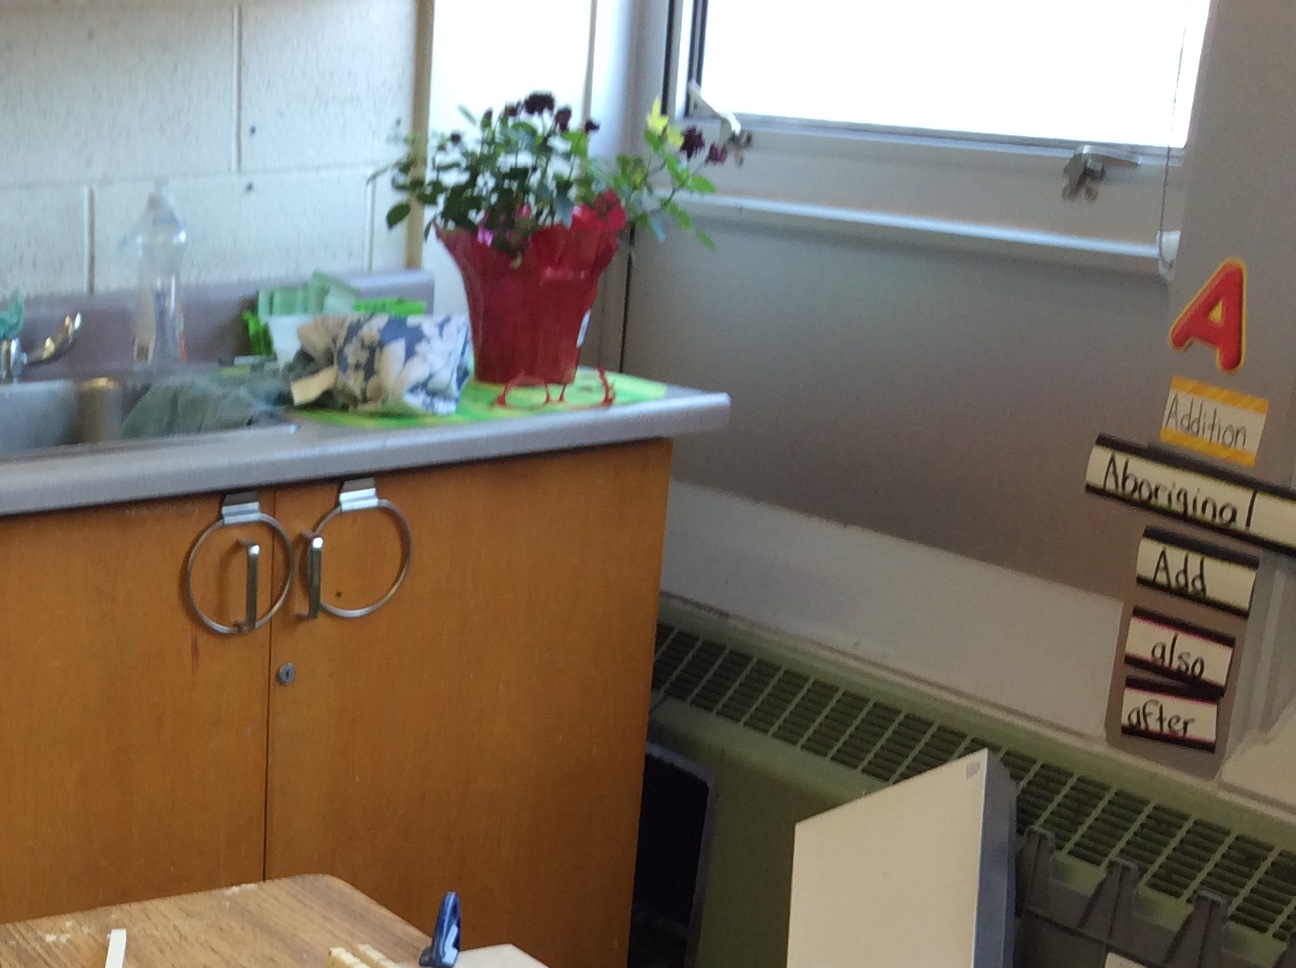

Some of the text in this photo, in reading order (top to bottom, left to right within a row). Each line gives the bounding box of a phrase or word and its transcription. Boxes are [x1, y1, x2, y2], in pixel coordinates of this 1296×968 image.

[1168, 255, 1247, 374] A
[1164, 392, 1247, 449] Addition
[1104, 451, 1257, 529] Aboriginal
[1153, 547, 1207, 592] Add
[1151, 633, 1205, 679] also
[1127, 699, 1196, 737] after
